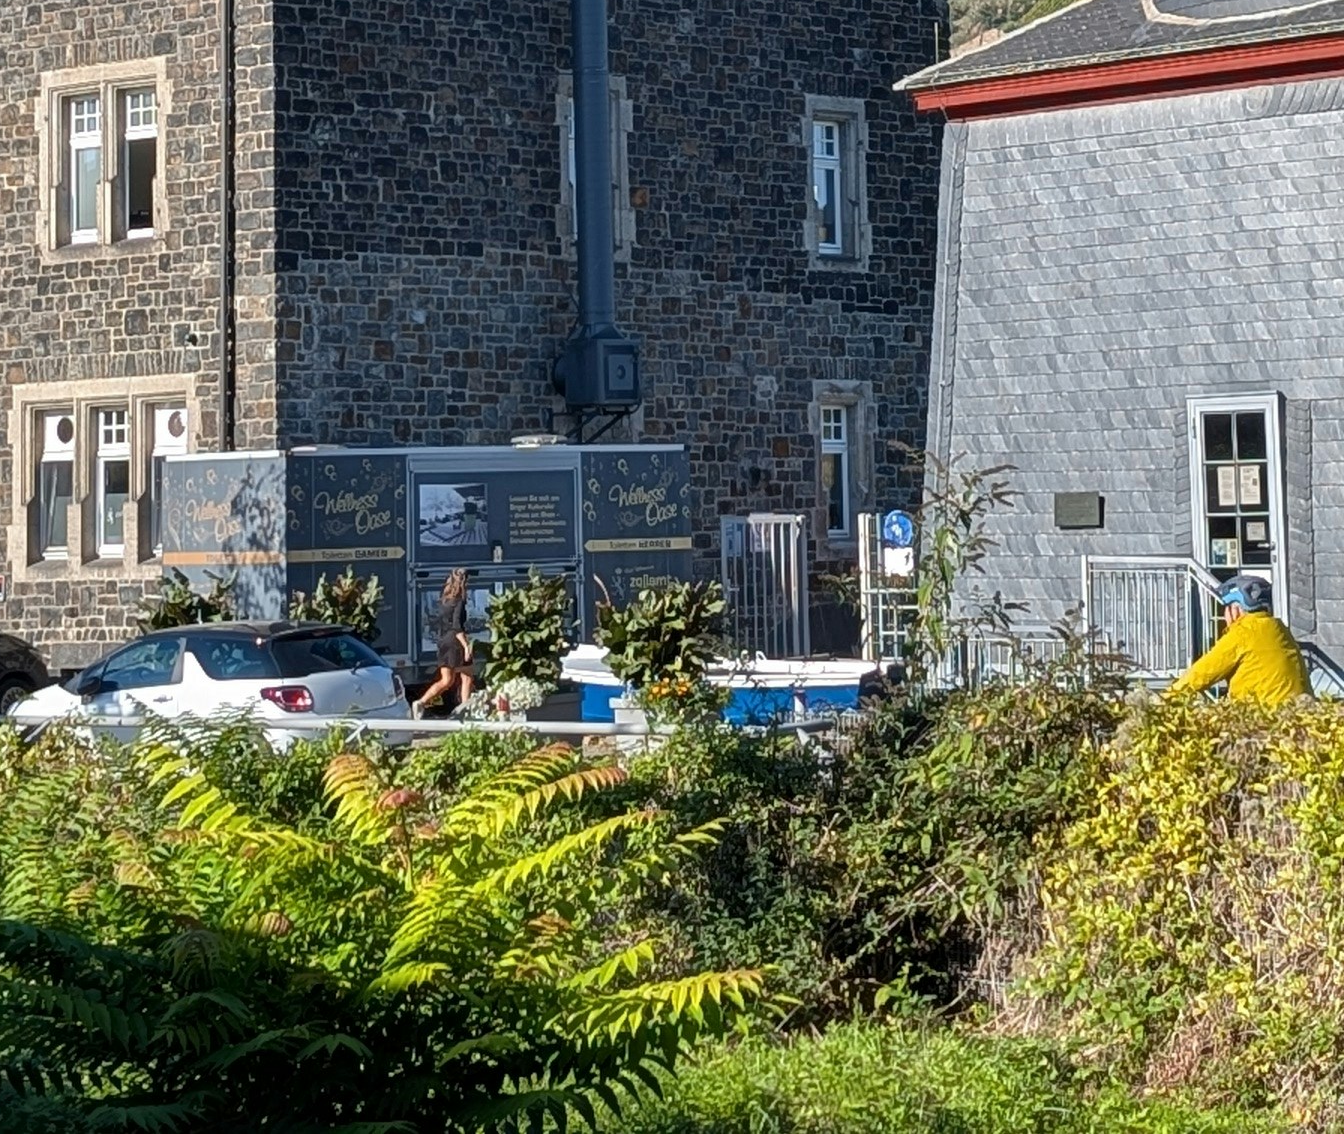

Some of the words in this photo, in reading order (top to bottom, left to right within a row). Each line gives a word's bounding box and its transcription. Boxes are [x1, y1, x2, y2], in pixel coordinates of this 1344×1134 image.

[313, 490, 379, 516] Wellness
[609, 483, 666, 507] Wellness
[355, 510, 391, 535] Oase
[646, 502, 677, 526] Oase
